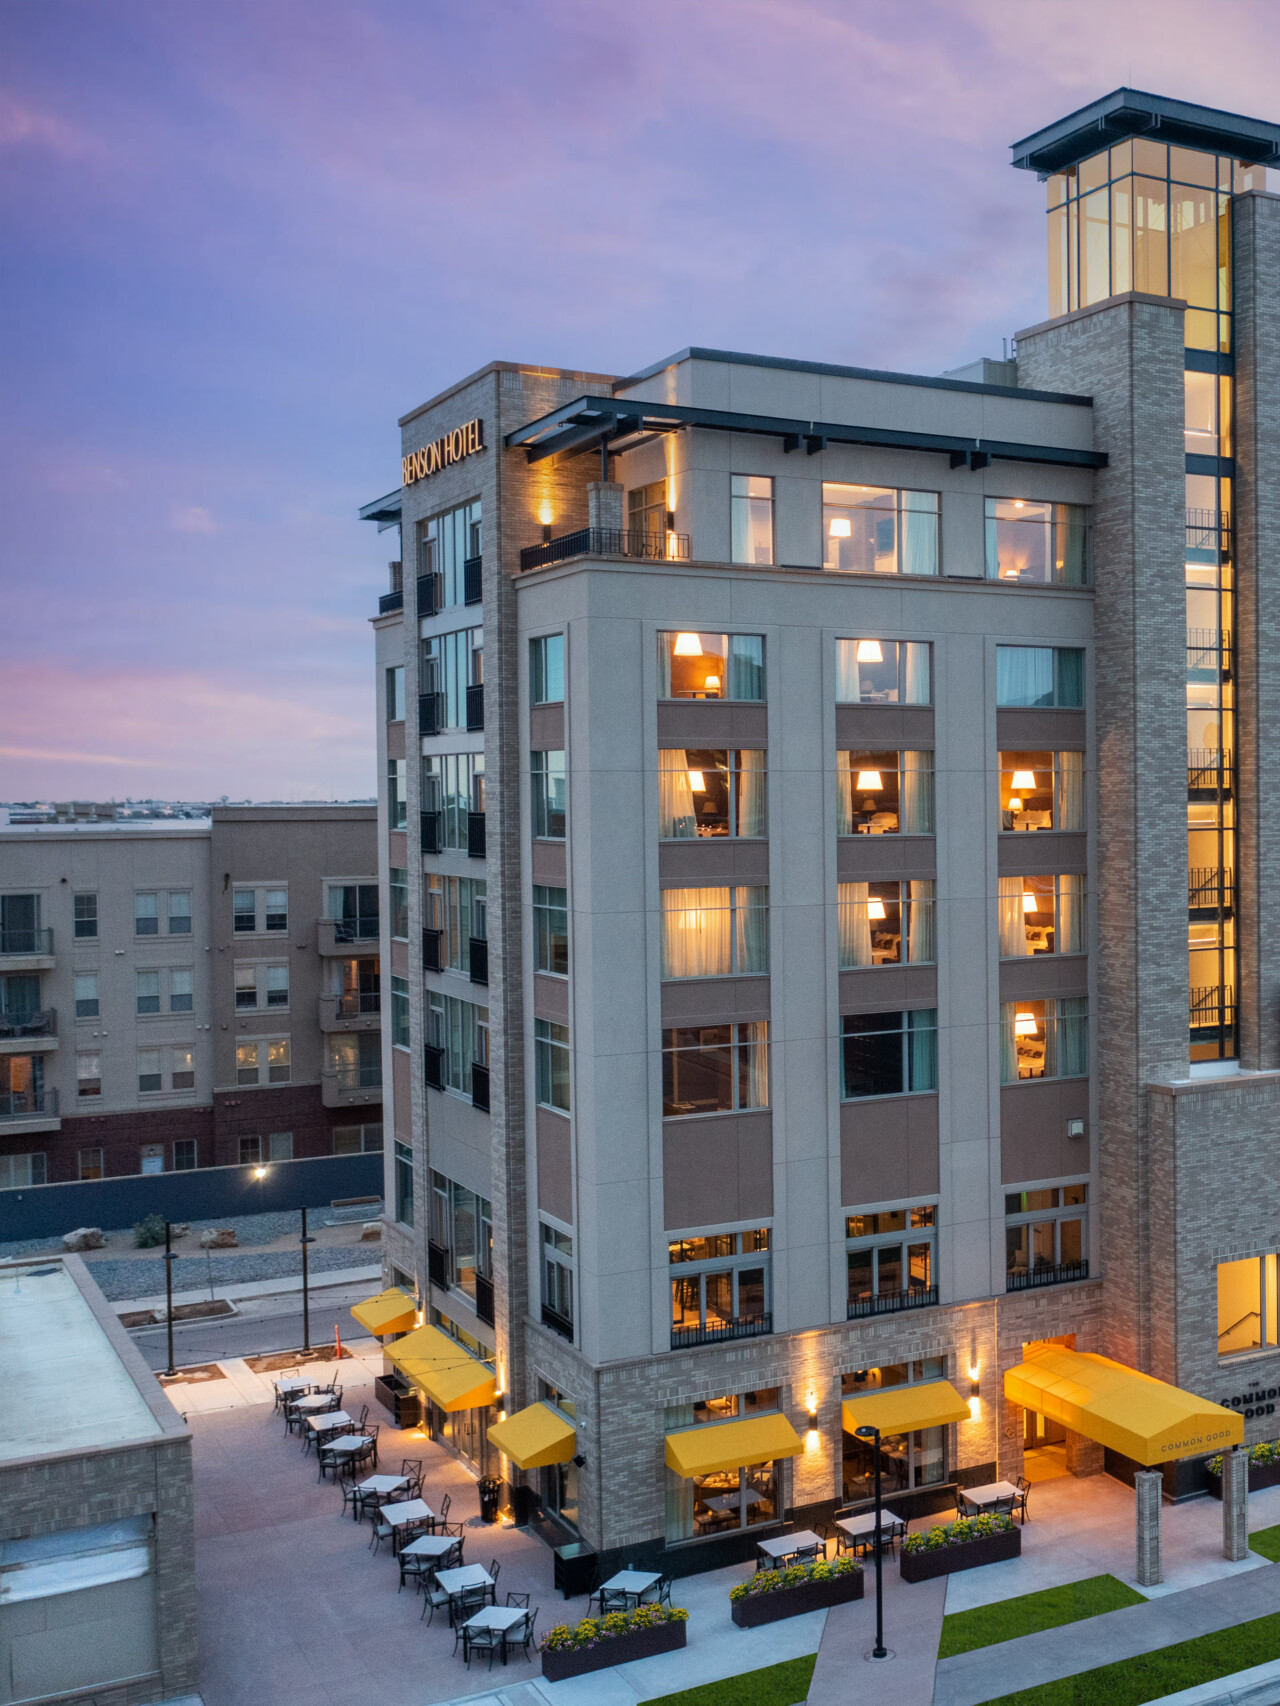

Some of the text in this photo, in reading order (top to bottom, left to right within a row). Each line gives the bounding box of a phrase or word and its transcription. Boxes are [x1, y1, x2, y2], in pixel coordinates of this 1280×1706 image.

[402, 418, 483, 486] BENSON HOTEL
[1236, 1403, 1275, 1419] OOD
[1161, 1436, 1203, 1453] COMMON
[1206, 1429, 1231, 1442] GOOD
